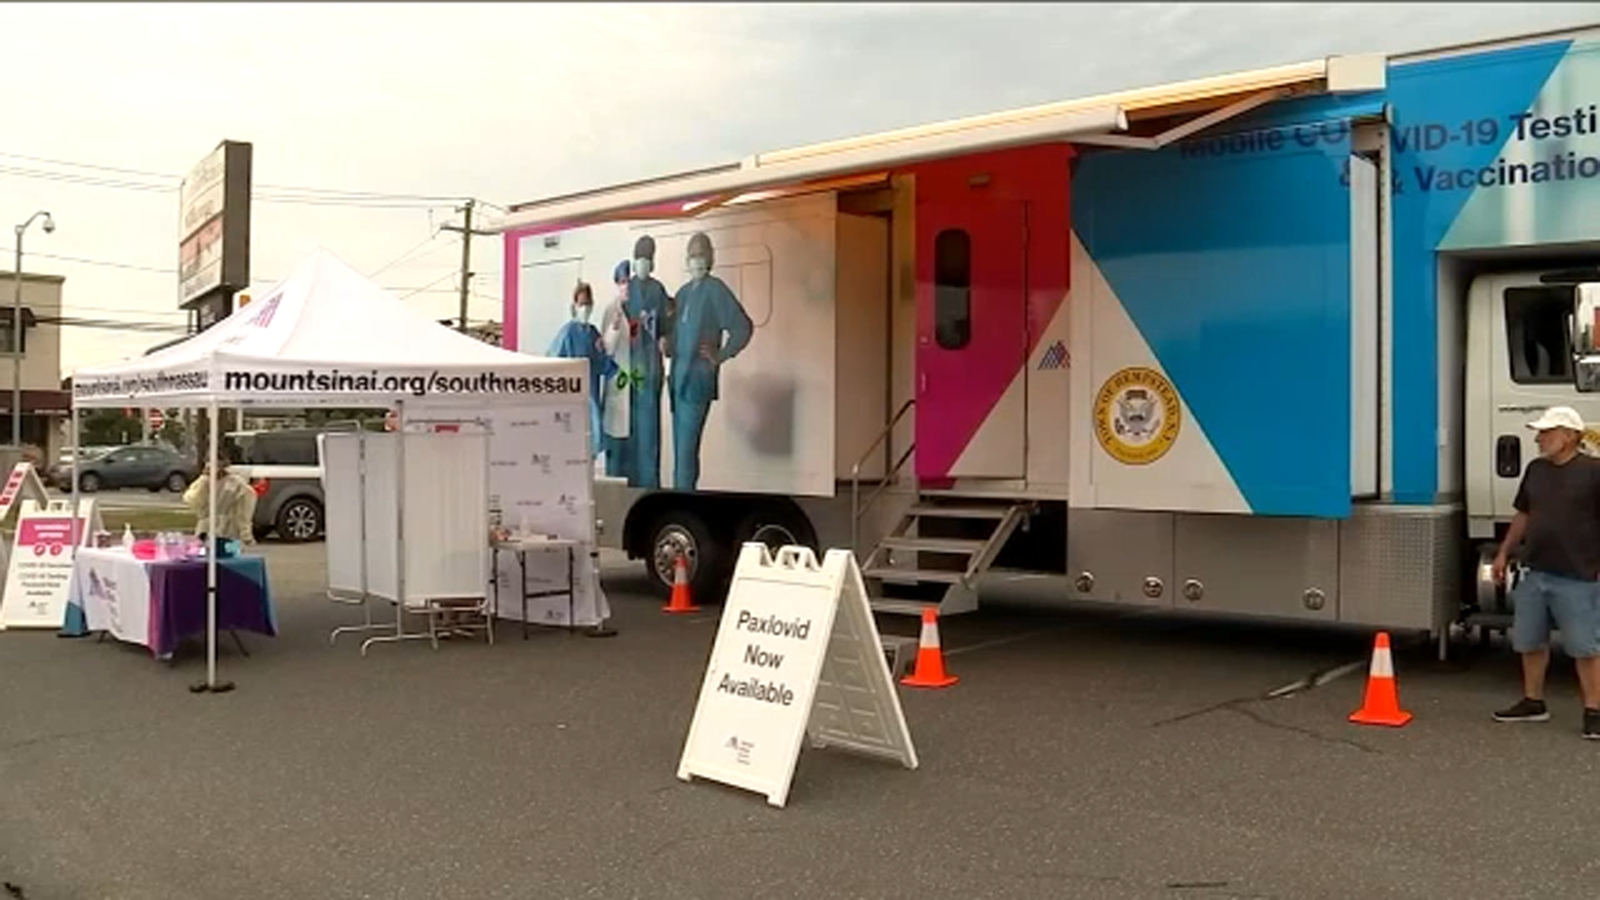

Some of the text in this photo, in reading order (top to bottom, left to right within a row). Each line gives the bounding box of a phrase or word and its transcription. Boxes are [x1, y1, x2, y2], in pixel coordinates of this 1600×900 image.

[224, 369, 582, 397] mountsinai.org/southnassau
[736, 608, 812, 640] Paxlovid
[743, 643, 785, 670] Now
[716, 672, 795, 706] Available
